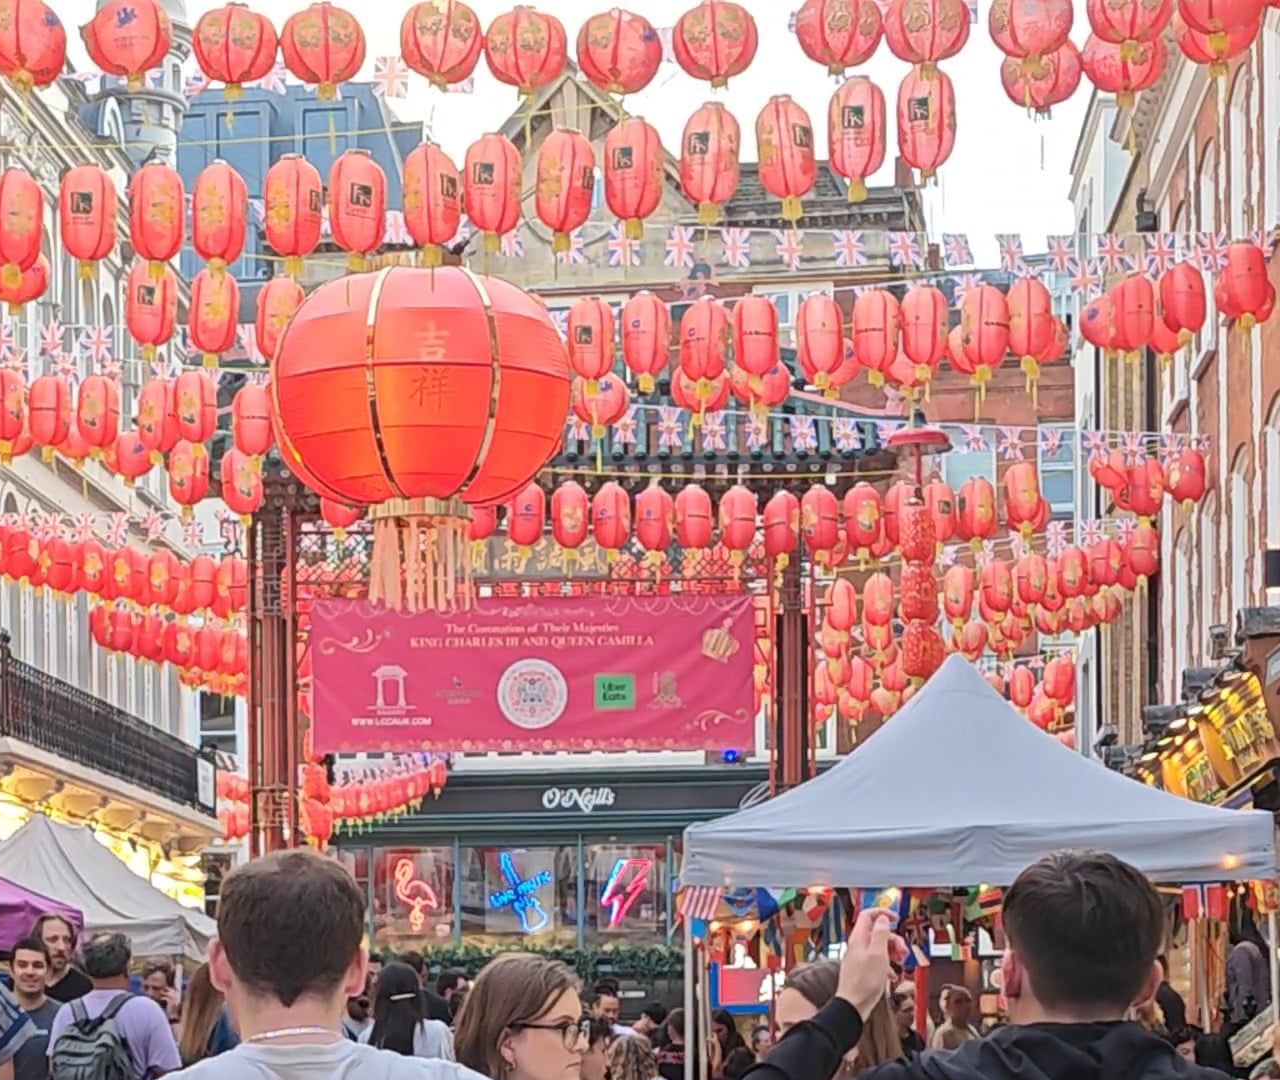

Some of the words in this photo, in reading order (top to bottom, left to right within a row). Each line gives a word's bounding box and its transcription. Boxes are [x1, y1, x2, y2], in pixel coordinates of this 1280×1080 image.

[443, 623, 466, 634] The
[410, 636, 442, 648] KING
[444, 636, 504, 648] CHARLES
[506, 636, 519, 648] III
[521, 635, 550, 647] AND
[551, 635, 596, 650] QUEEN
[597, 635, 655, 647] CAMILLA
[602, 682, 627, 692] Uber
[542, 786, 617, 814] O'Neill's
